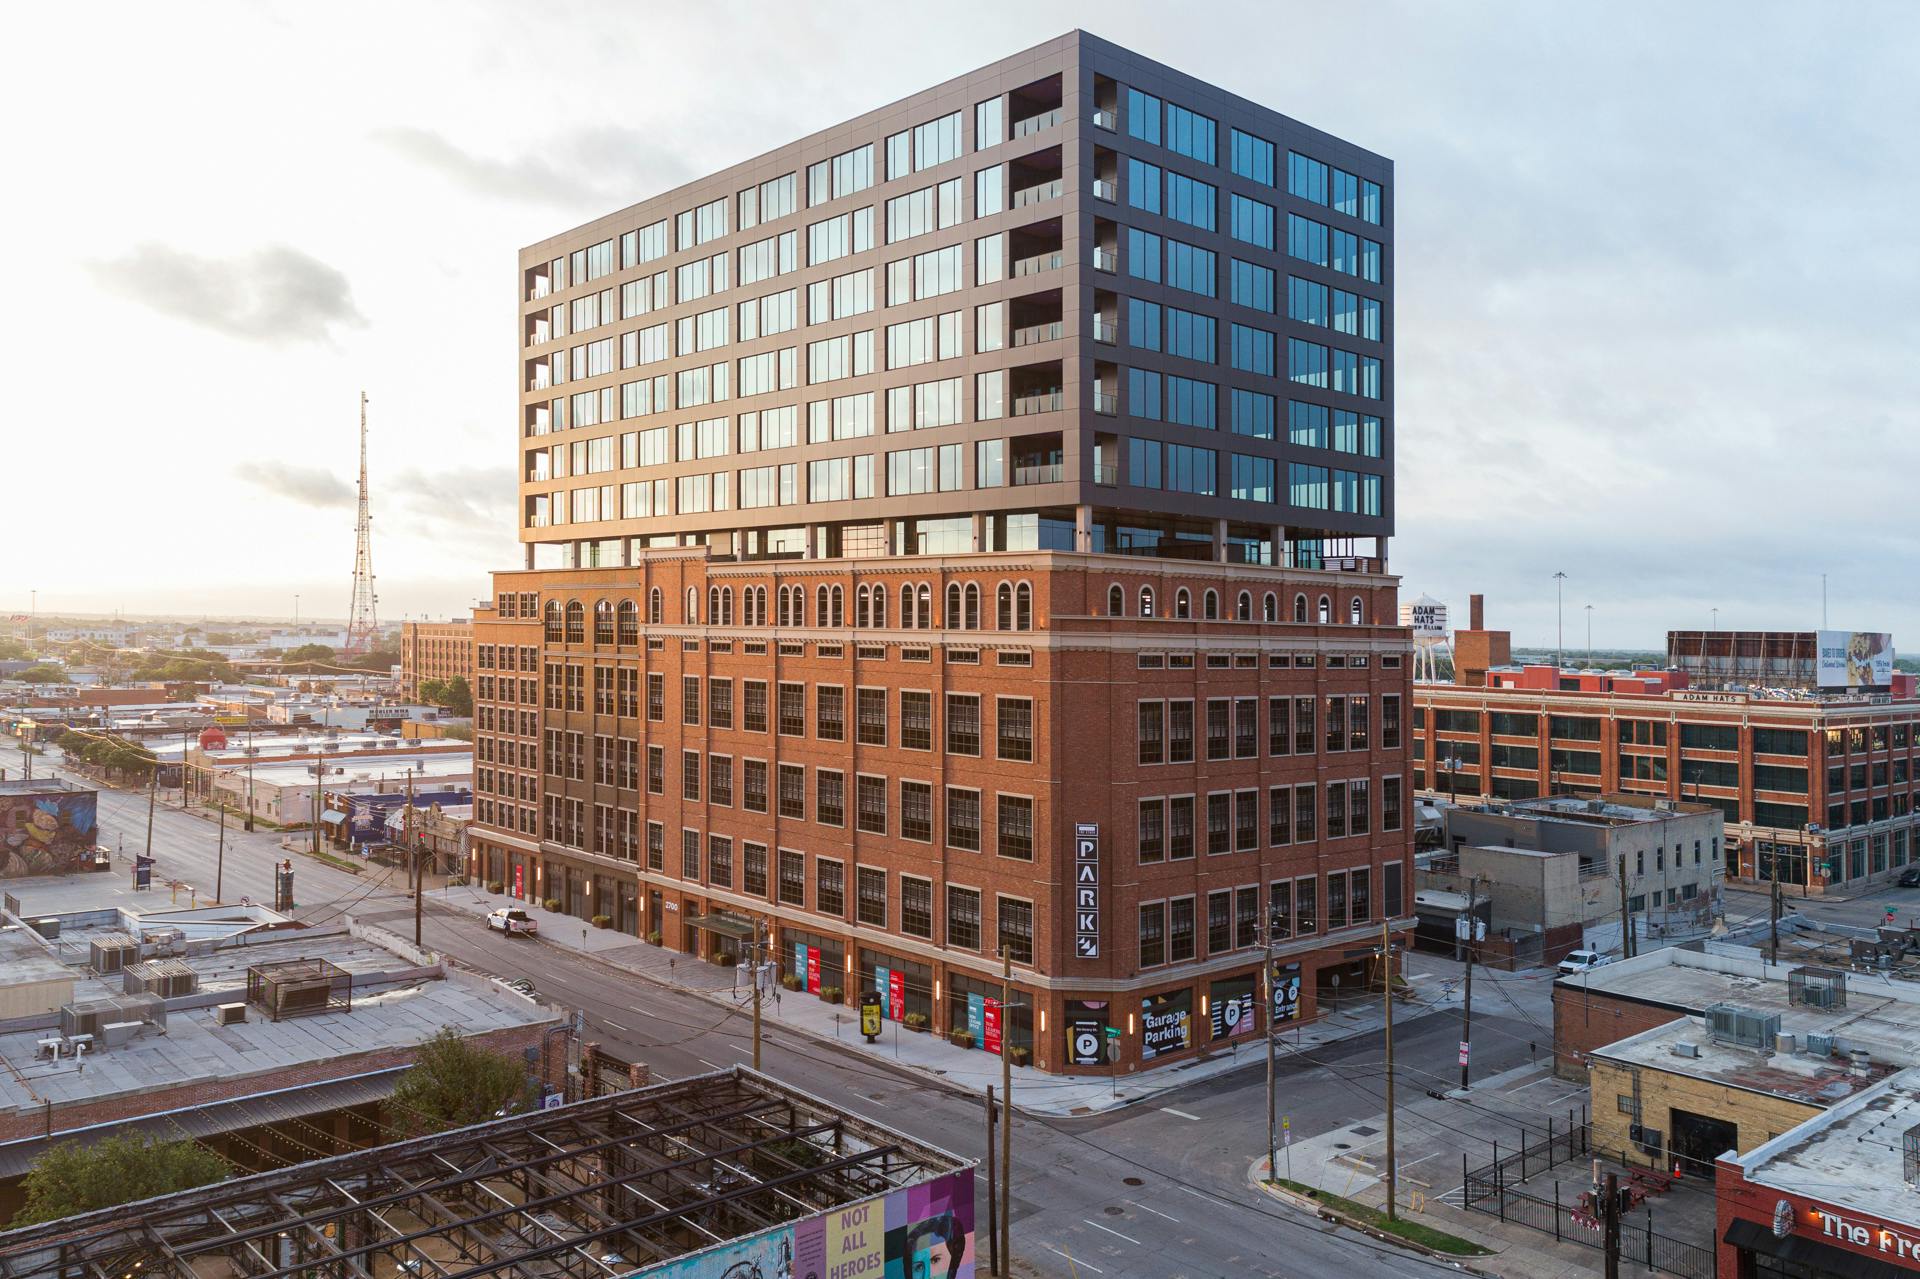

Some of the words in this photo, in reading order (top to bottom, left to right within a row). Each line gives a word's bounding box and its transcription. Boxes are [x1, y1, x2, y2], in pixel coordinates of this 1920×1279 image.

[1412, 606, 1436, 615] ADAM
[1414, 615, 1434, 624] HATS
[1080, 841, 1096, 930] PARK
[665, 901, 679, 911] 2700
[1146, 1010, 1187, 1028] Garage
[1229, 1010, 1236, 1021] P
[1145, 1025, 1187, 1044] Parking
[1083, 1039, 1092, 1049] P
[841, 1206, 869, 1230] NOT
[1818, 1211, 1870, 1246] The
[842, 1231, 867, 1254] ALL
[830, 1251, 881, 1279] HEROES
